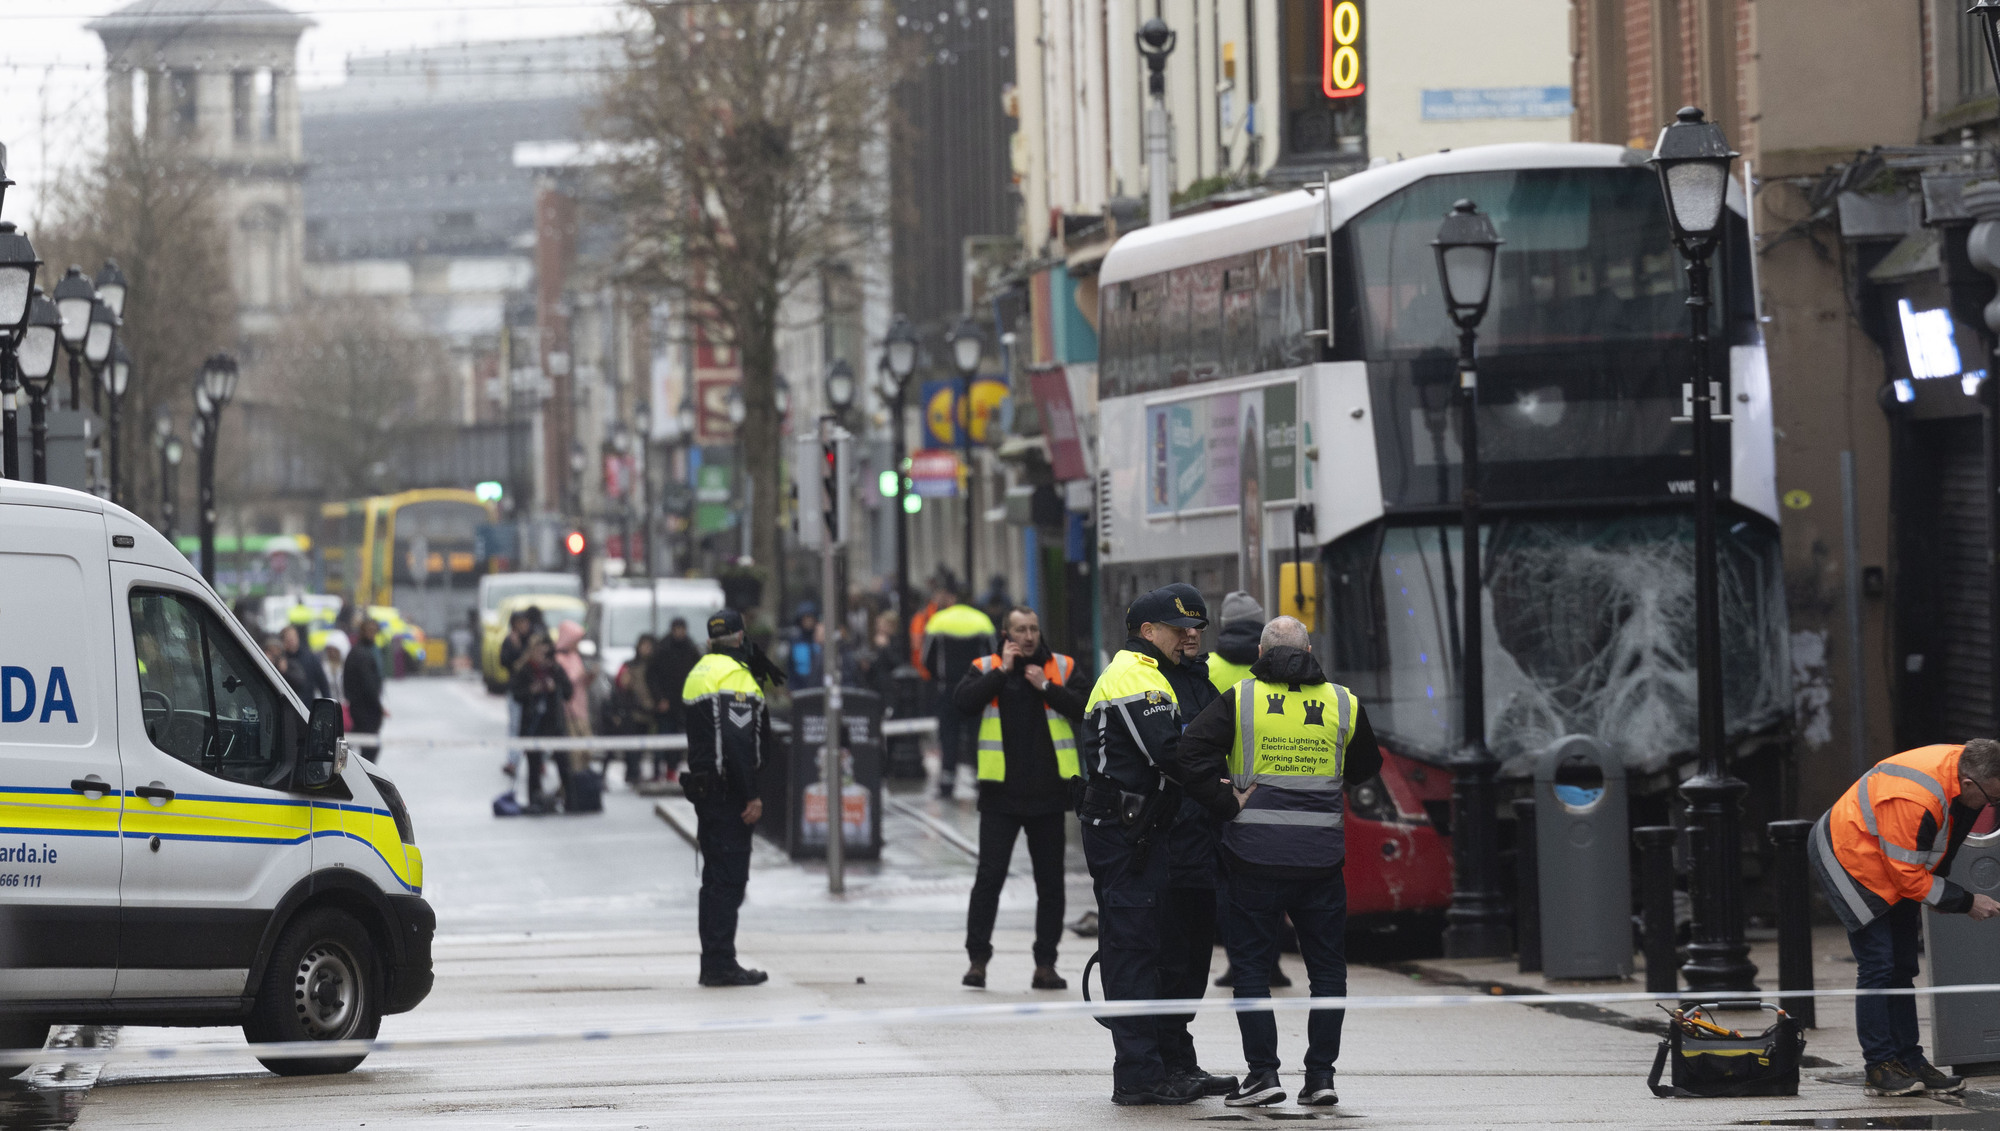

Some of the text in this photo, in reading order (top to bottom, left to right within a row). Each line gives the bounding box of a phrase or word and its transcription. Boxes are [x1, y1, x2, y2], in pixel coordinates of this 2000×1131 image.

[1, 665, 79, 723] DA
[1289, 737, 1320, 746] Lighting
[1261, 754, 1293, 763] Working
[1294, 756, 1318, 765] Safely
[1274, 764, 1316, 774] Dublin City
[0, 842, 57, 864] arda.ie
[0, 873, 42, 888] 666 111
